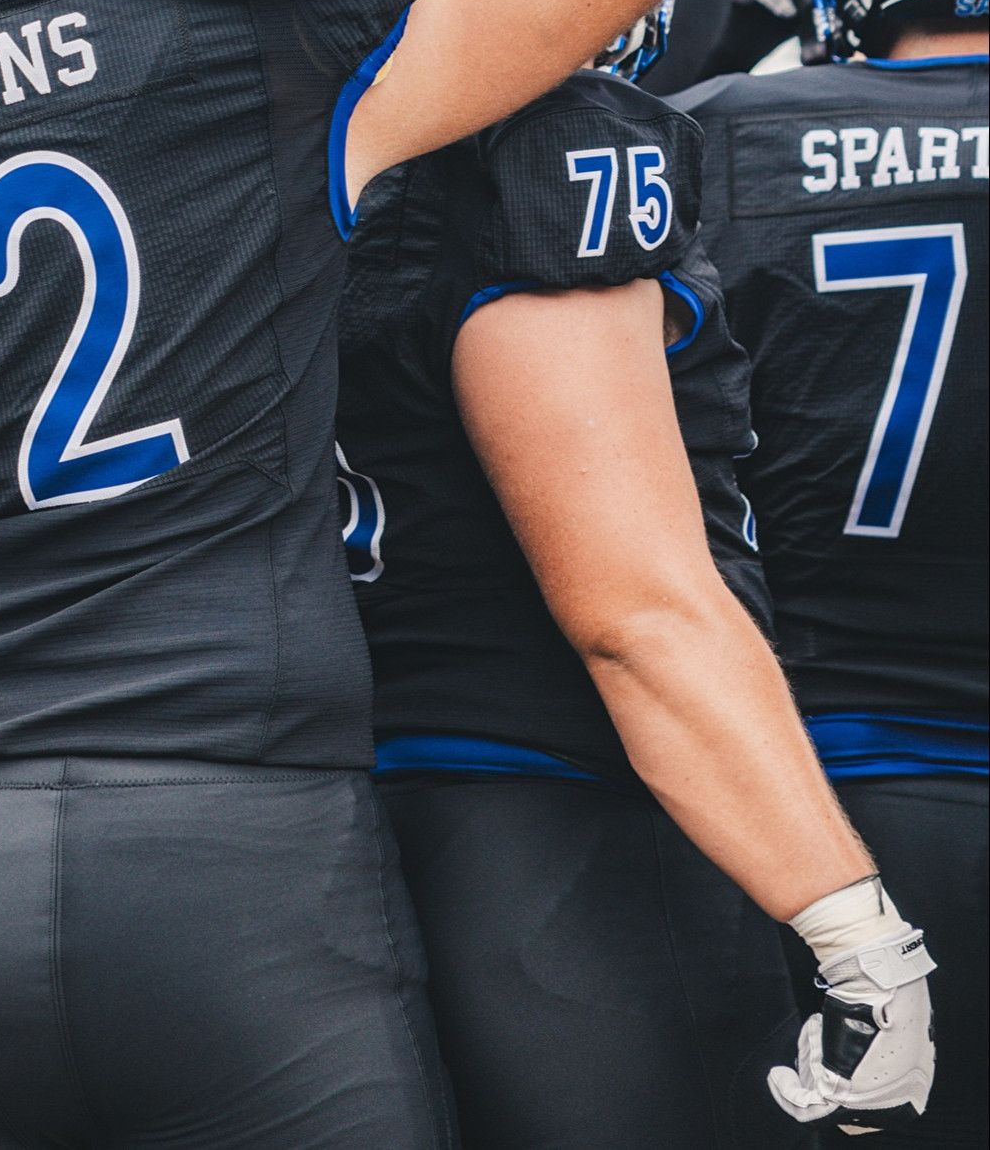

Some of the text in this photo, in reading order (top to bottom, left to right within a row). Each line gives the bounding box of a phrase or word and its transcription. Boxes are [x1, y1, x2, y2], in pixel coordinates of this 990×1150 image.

[566, 146, 673, 258] 75
[802, 127, 989, 193] SPART
[812, 223, 968, 538] 7
